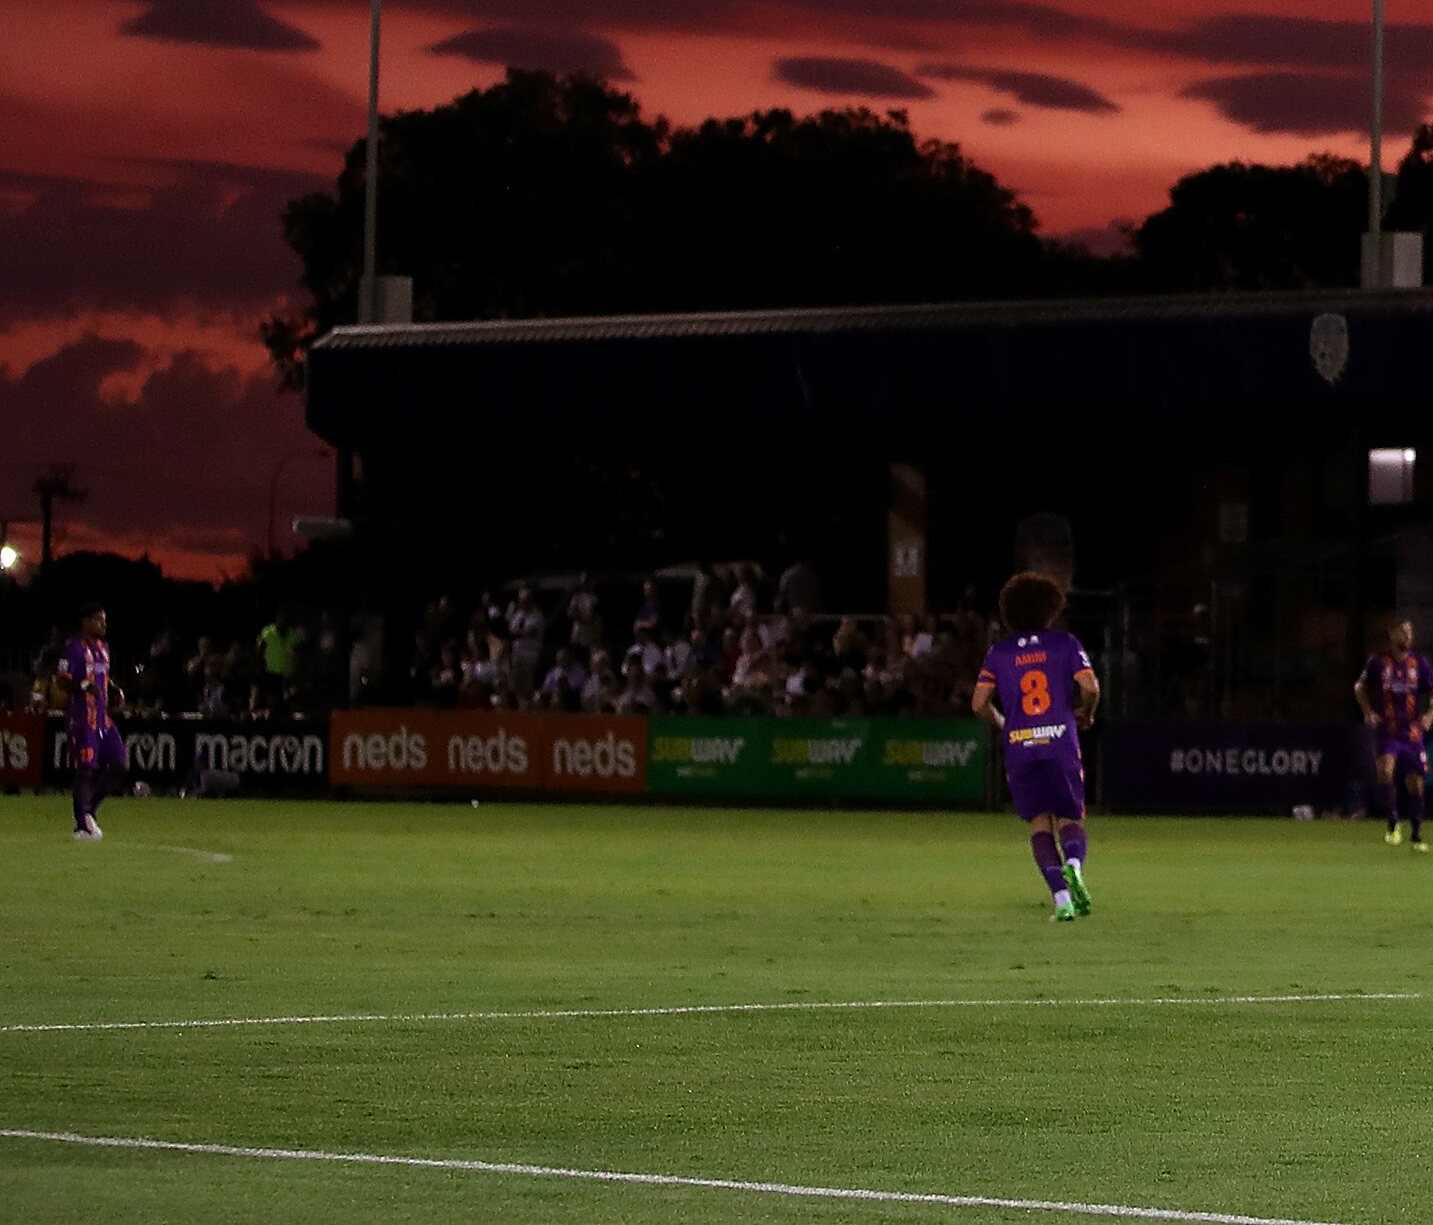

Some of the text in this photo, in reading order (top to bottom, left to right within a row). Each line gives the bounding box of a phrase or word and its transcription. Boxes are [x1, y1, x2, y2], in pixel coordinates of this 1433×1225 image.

[1020, 670, 1051, 716] 8
[195, 732, 323, 773] macron
[342, 725, 429, 770] neds
[448, 727, 529, 774] neds
[552, 731, 637, 777] neds
[1009, 724, 1066, 744] SUBWAY
[1170, 748, 1323, 775] #ONEGLORY
